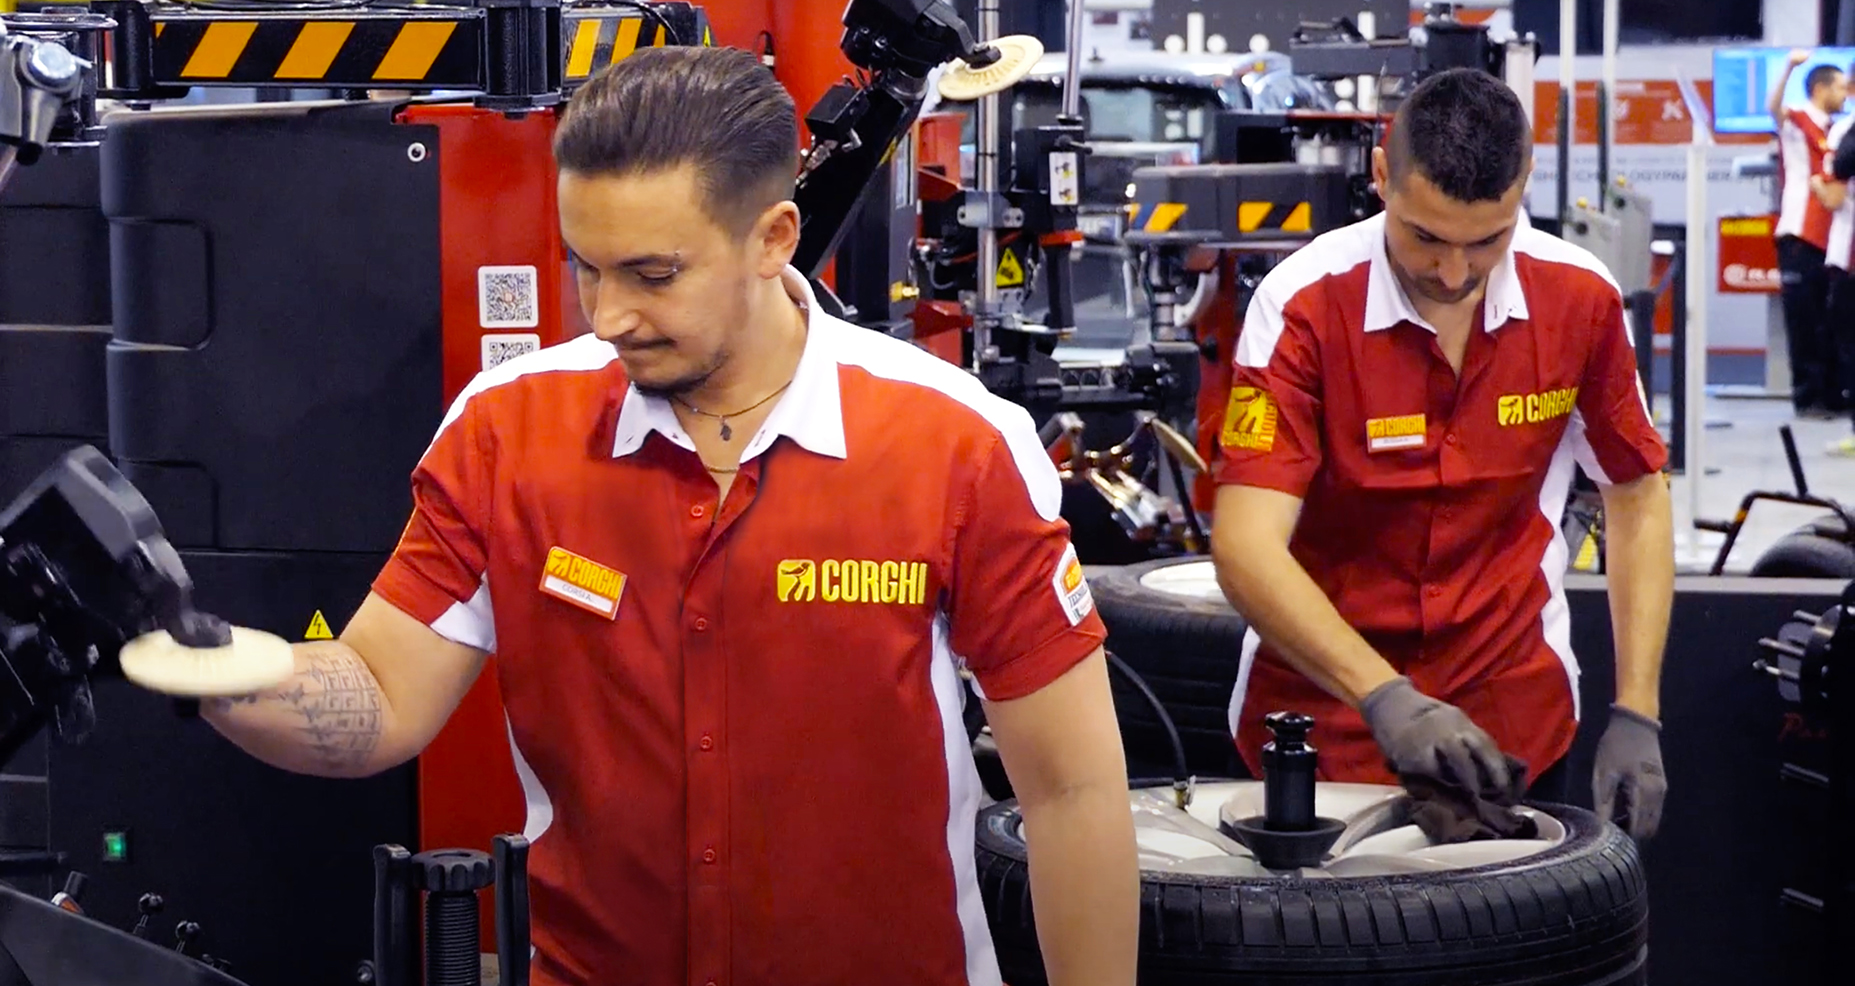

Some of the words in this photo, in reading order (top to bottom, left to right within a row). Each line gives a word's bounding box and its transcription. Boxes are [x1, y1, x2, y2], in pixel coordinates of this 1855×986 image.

[1526, 386, 1578, 423] CORGHI
[568, 557, 625, 600] CORGHI
[821, 558, 928, 605] CORGHI
